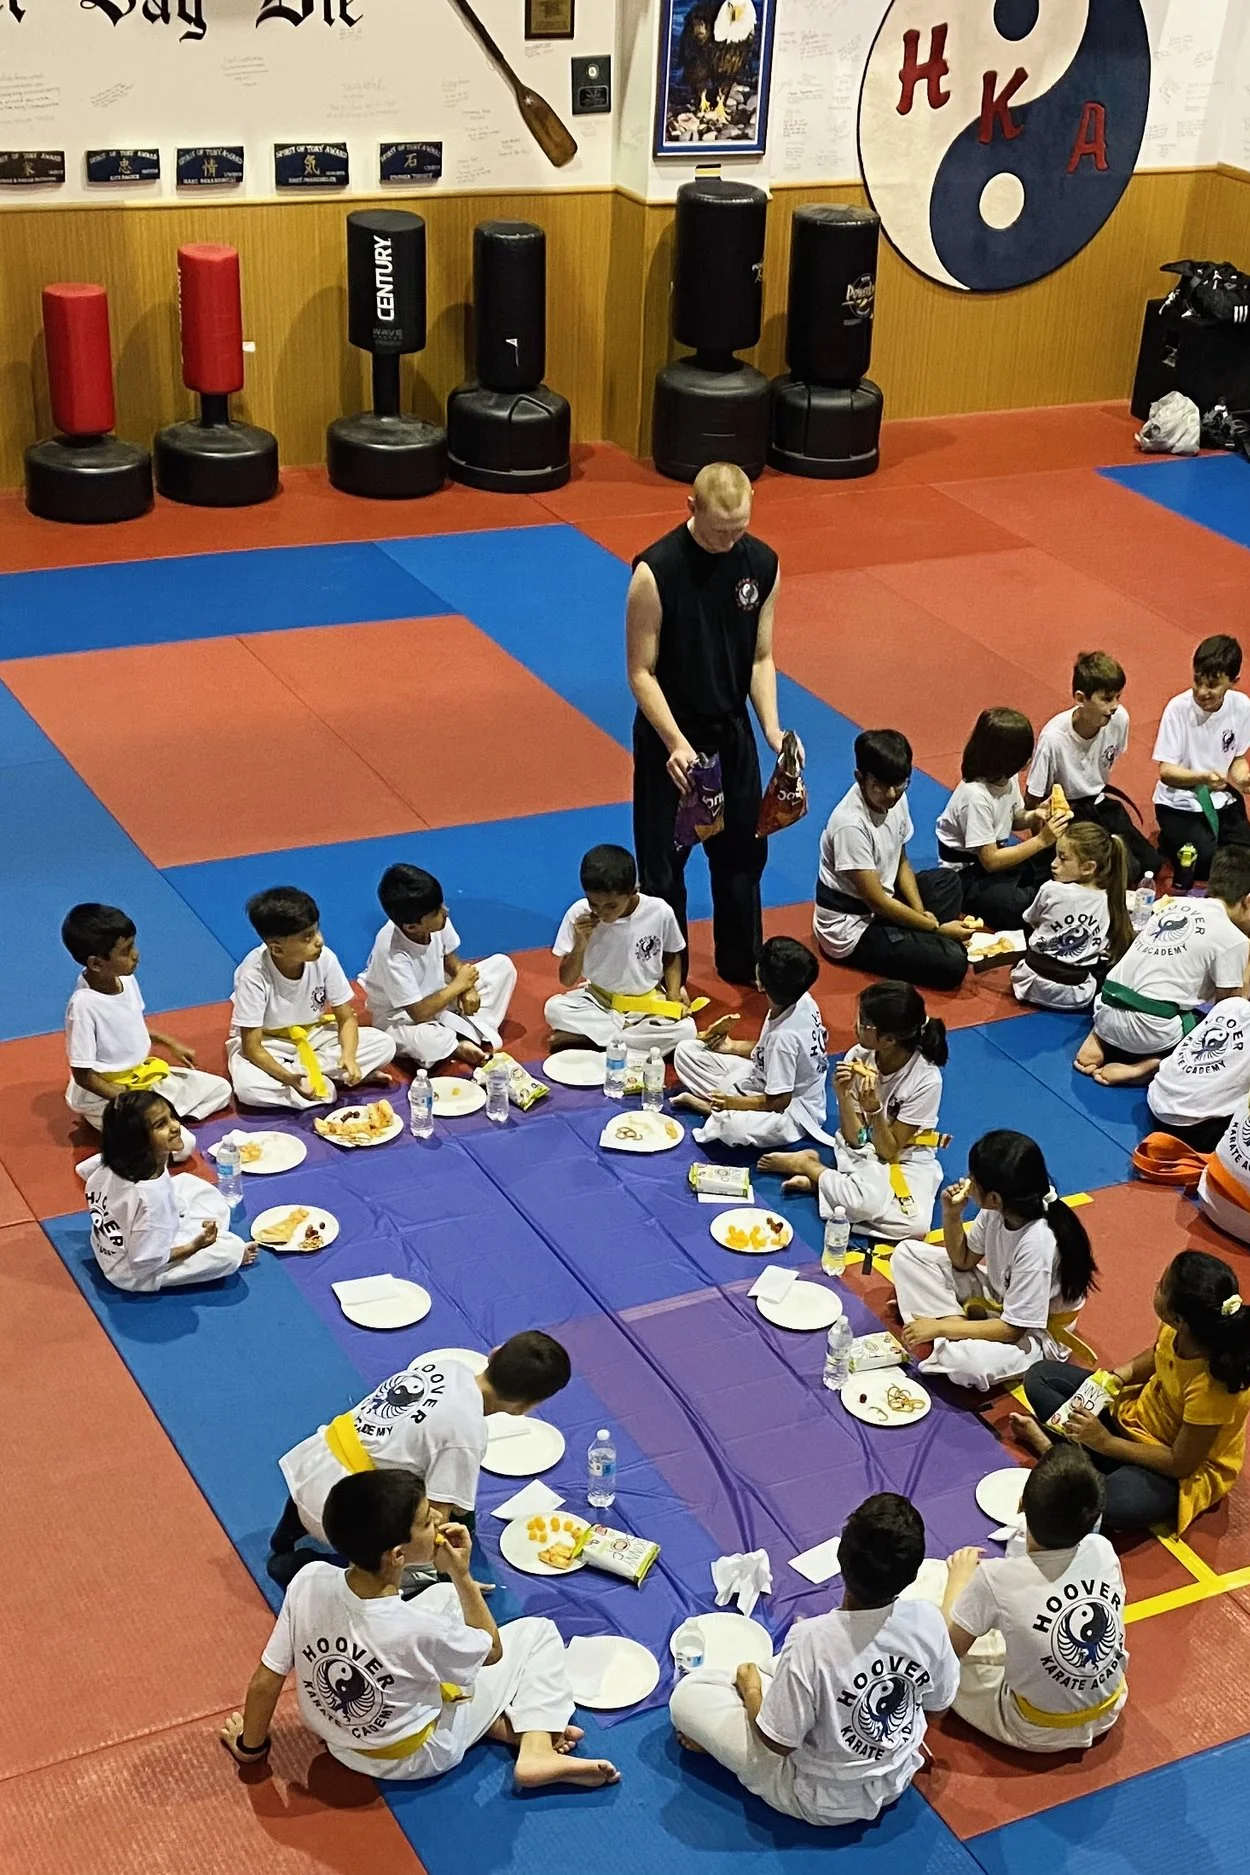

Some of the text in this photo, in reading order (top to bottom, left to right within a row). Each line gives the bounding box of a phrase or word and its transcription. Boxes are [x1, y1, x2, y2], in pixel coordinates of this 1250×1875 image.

[896, 22, 1110, 175] H K A
[373, 235, 394, 320] CENTURY
[1050, 914, 1101, 946] HOOVER
[1142, 943, 1188, 956] ACADEMY
[1229, 1122, 1243, 1163] KARATE
[411, 1364, 445, 1424] OOVER
[1032, 1580, 1121, 1633] HOOVER
[302, 1637, 395, 1690] HOOVER
[837, 1656, 931, 1707] HOOVER
[1040, 1655, 1086, 1690] KARATE
[351, 1704, 396, 1739] CADEMY
[841, 1725, 885, 1760] KARATE
